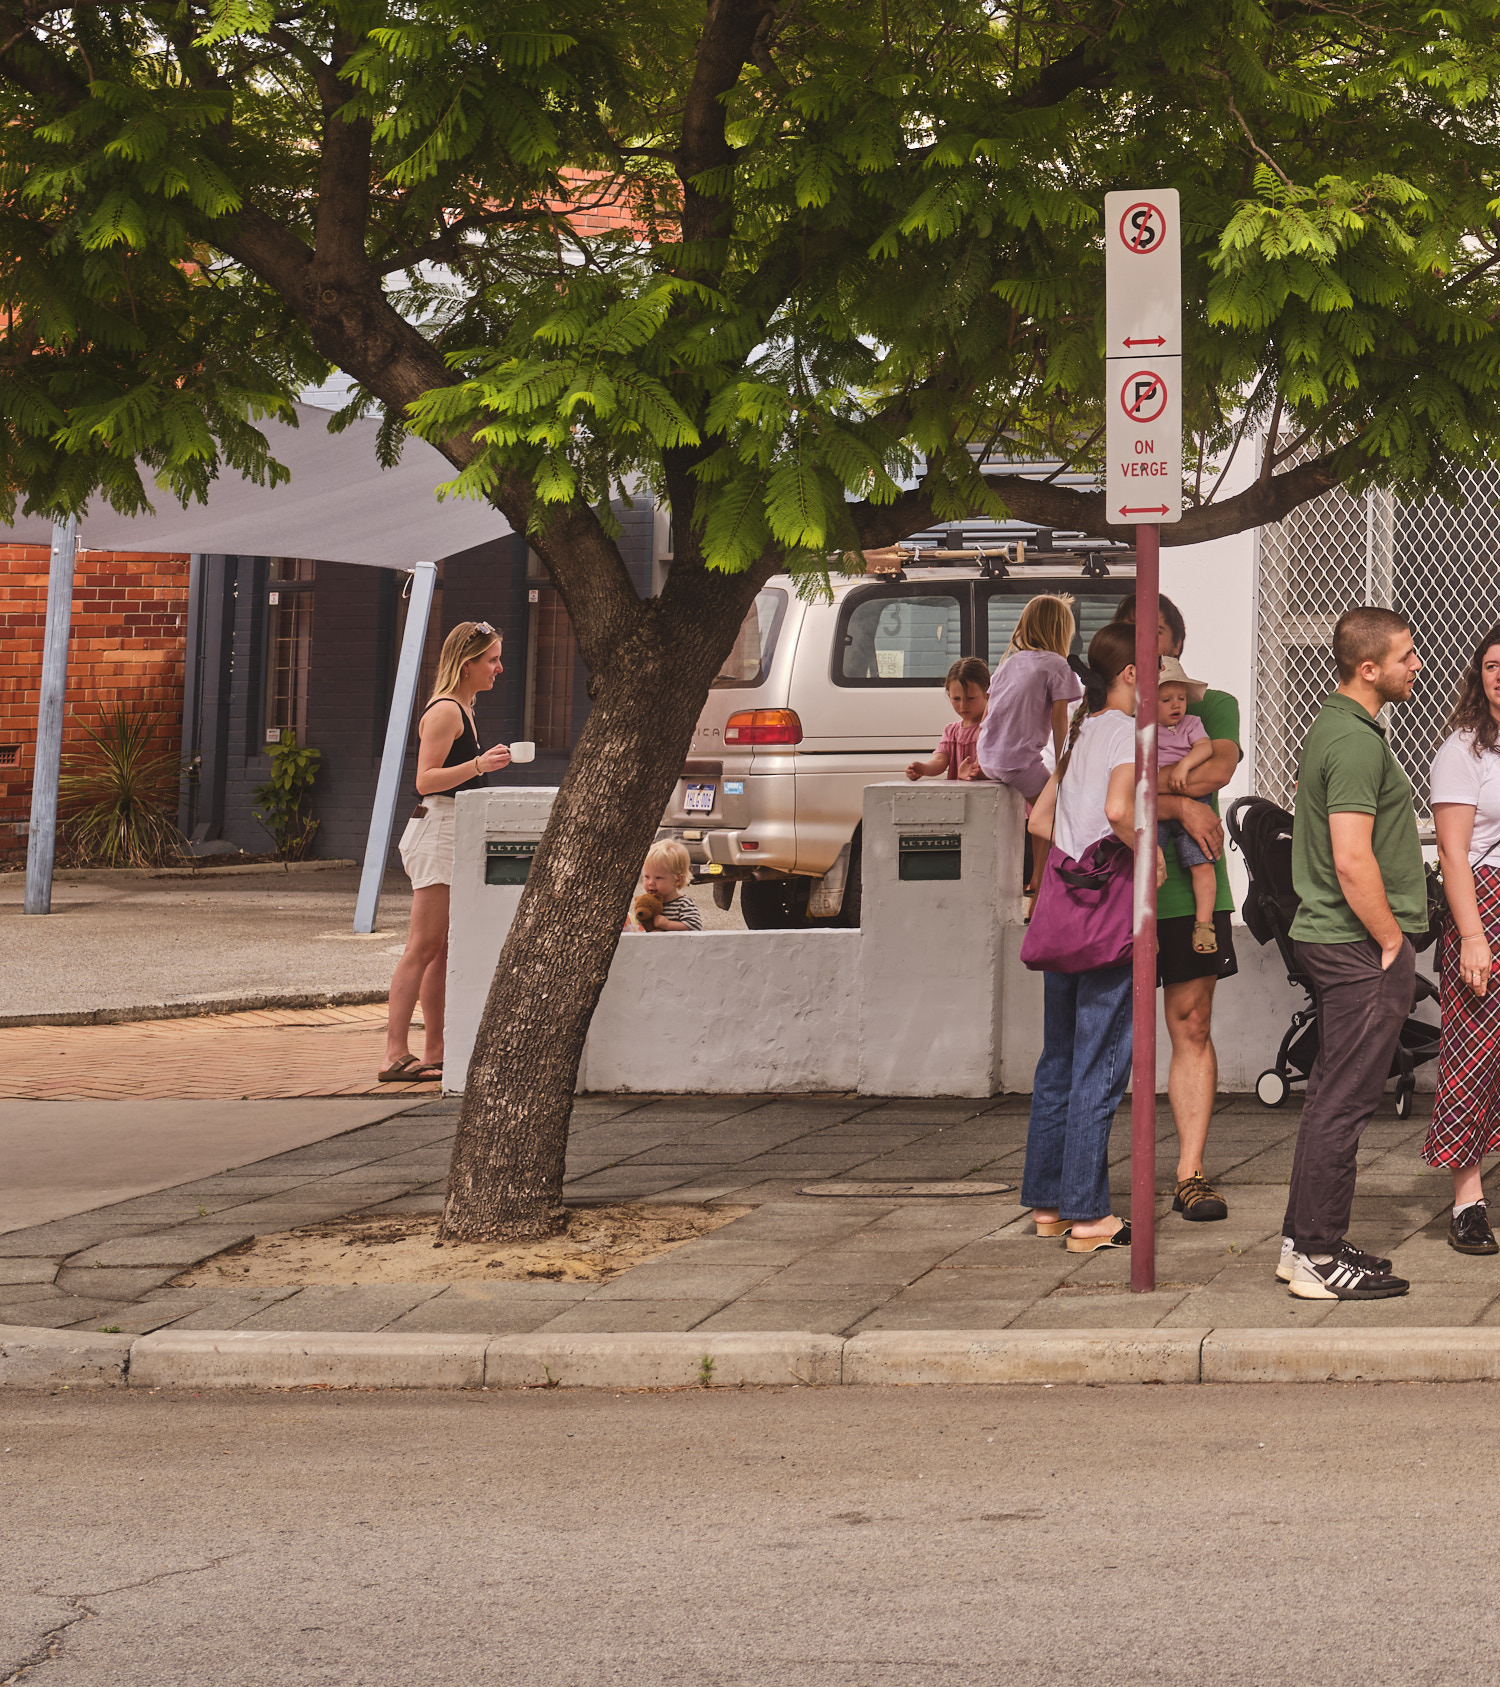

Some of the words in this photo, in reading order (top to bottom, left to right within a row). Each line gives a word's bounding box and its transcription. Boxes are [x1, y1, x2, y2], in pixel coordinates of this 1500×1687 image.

[1134, 439, 1154, 455] ON
[1121, 461, 1168, 477] VERGE
[878, 653, 897, 663] DERY
[697, 728, 720, 737] ICA
[901, 839, 959, 847] LETTERS
